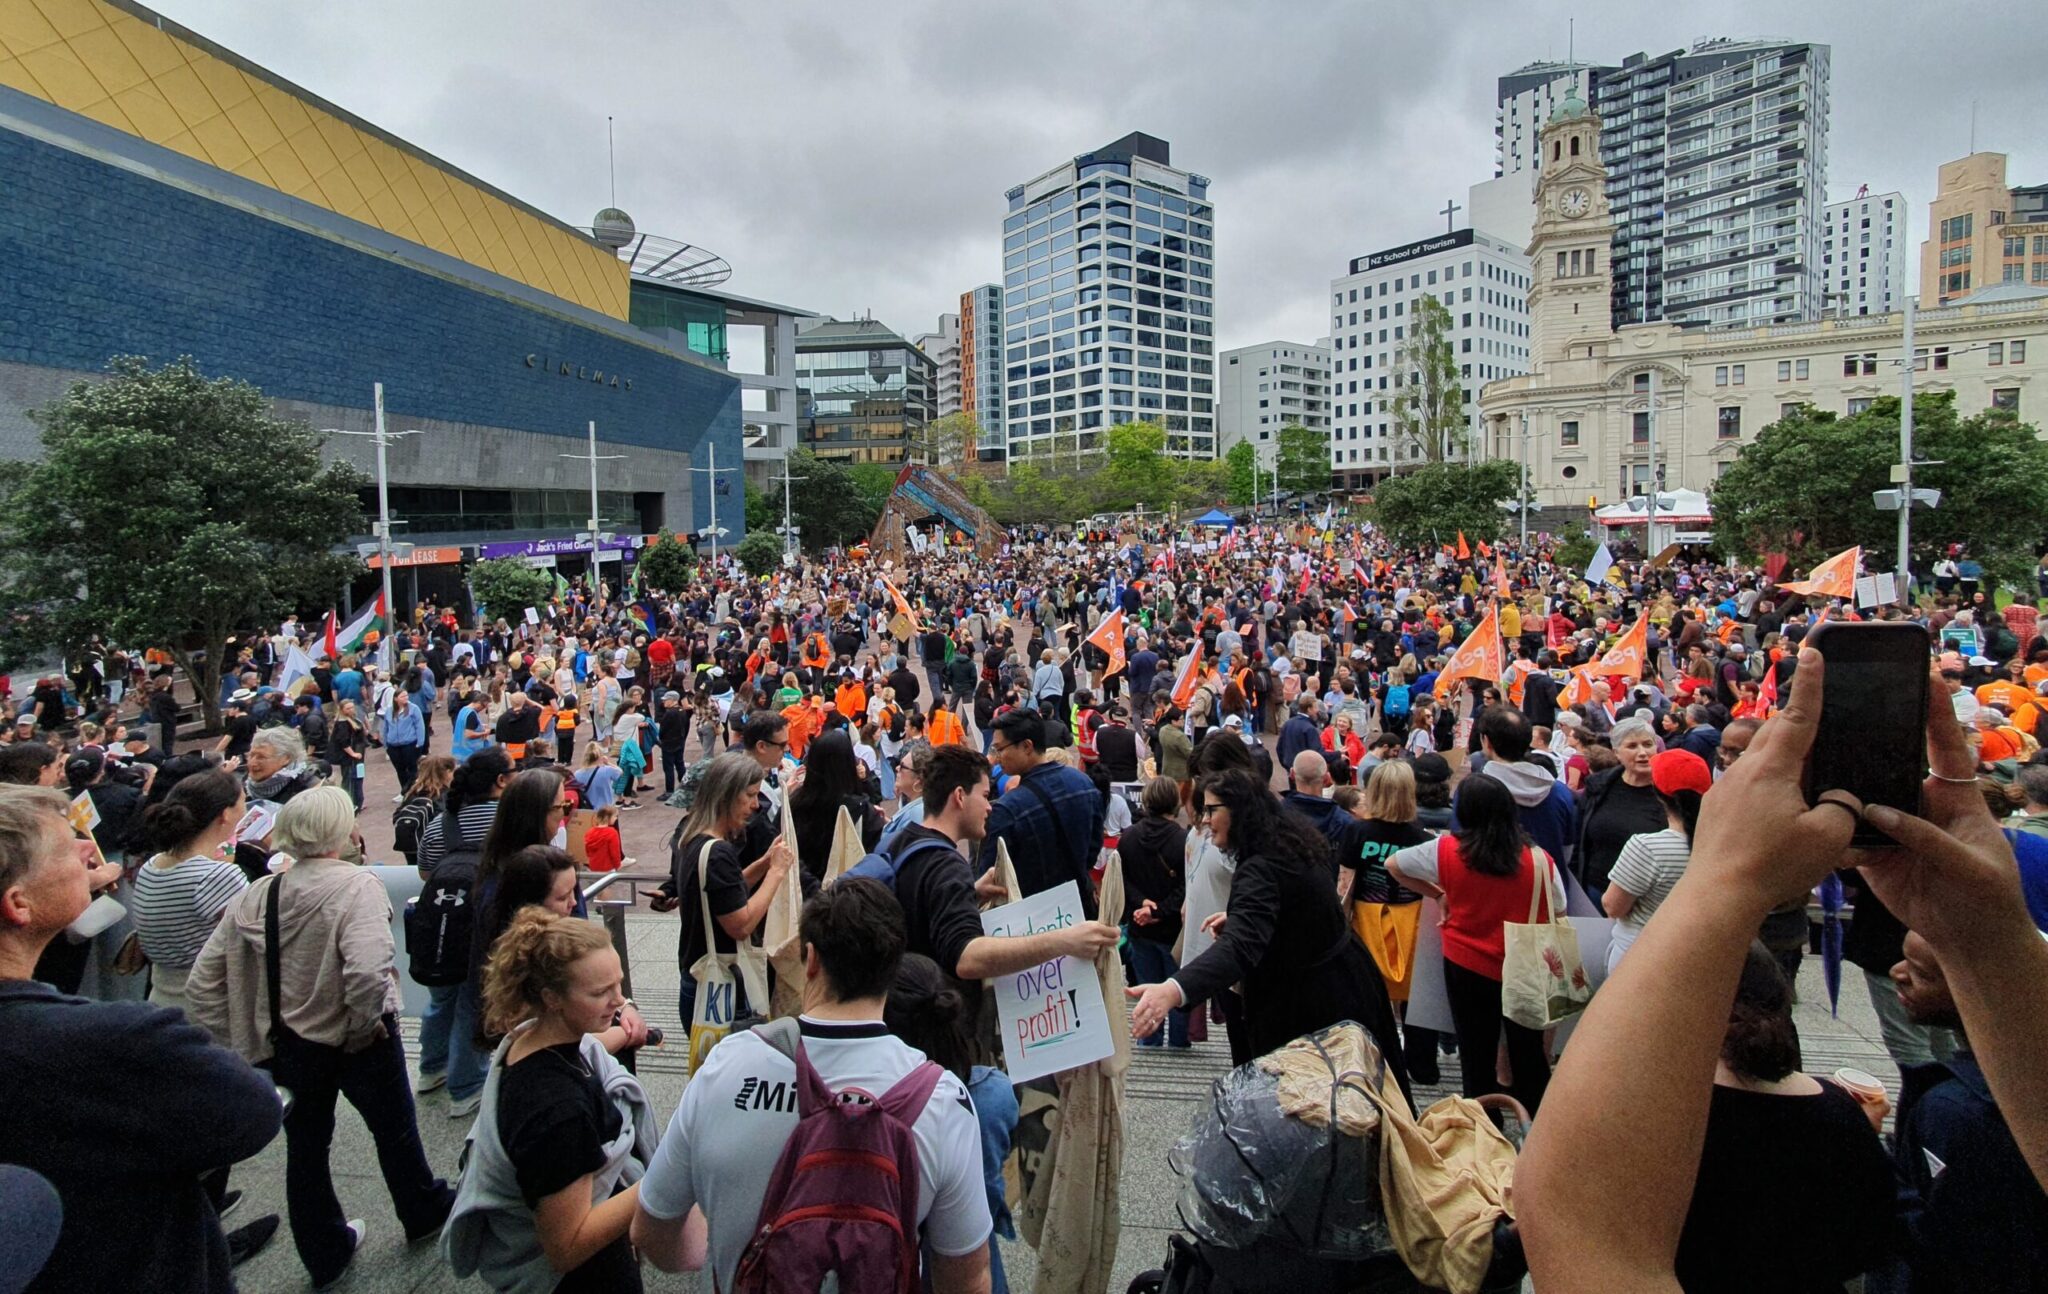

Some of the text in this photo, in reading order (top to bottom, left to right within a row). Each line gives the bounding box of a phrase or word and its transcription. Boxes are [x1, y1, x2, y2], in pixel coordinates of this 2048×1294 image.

[1384, 249, 1410, 262] School
[1411, 246, 1421, 255] of
[1423, 238, 1456, 251] Tourism
[525, 353, 633, 391] CINEMAS
[412, 550, 438, 563] LEASE
[536, 543, 556, 552] Jack's
[557, 541, 573, 551] Fried
[992, 905, 1072, 937] tdents
[1017, 955, 1067, 1001] over
[1017, 988, 1081, 1059] profit!
